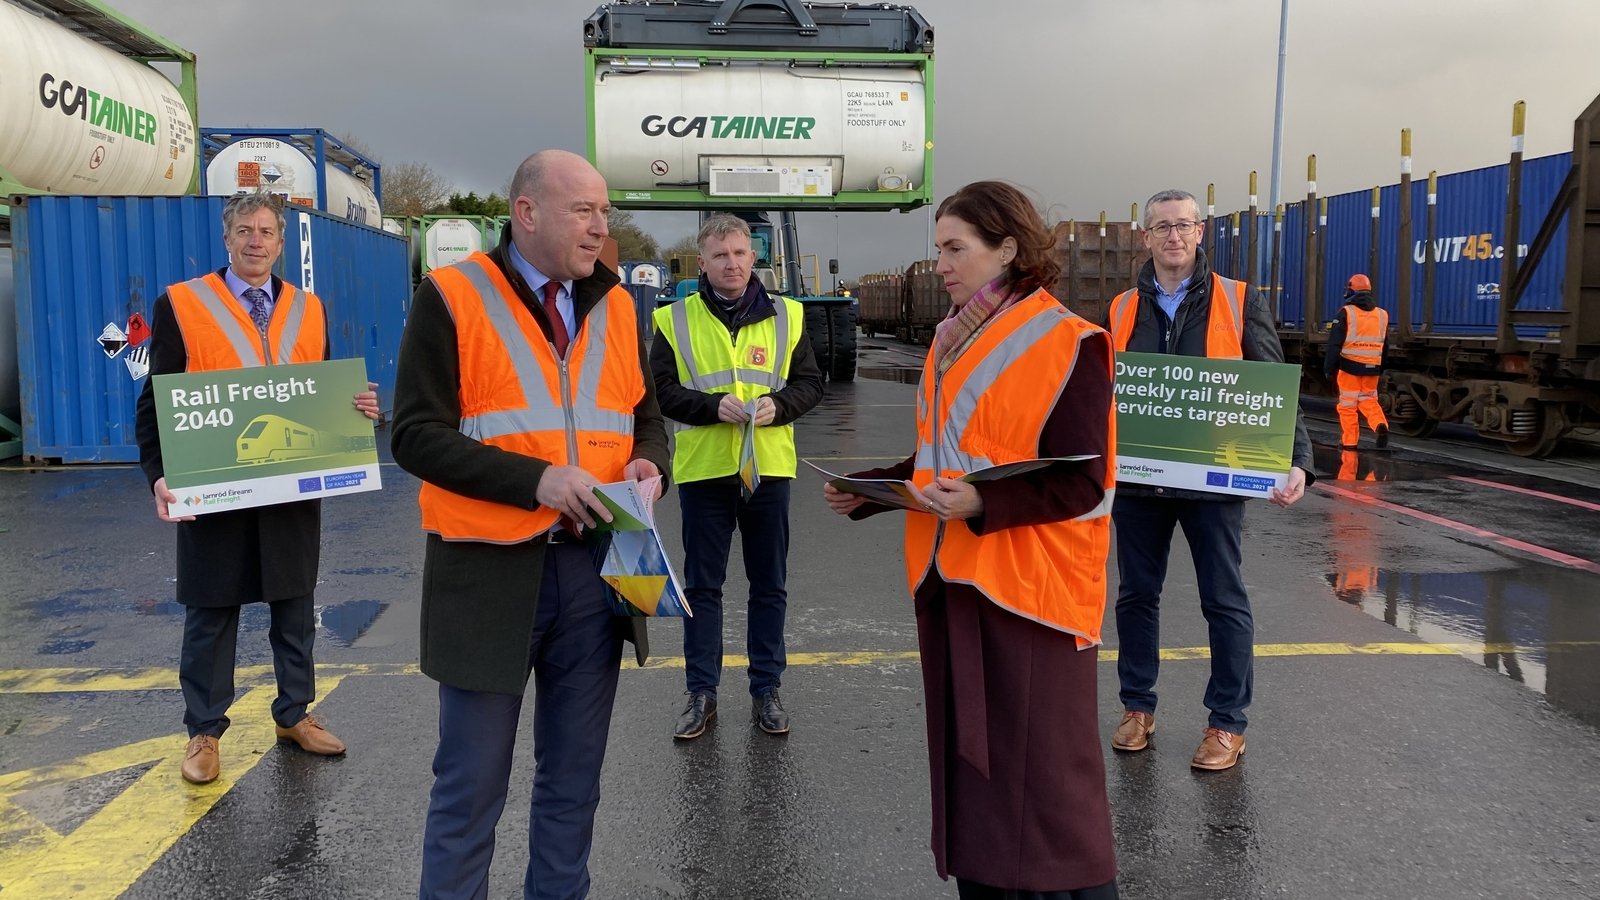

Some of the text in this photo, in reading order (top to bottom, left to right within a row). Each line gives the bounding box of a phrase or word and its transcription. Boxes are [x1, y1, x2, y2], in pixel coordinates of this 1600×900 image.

[39, 72, 157, 146] GCATAINER
[641, 114, 816, 140] GCATAINER
[847, 119, 906, 127] FOODSTUFF ONLY
[240, 141, 255, 149] BTEU
[1115, 361, 1239, 385] Over 100 new
[171, 377, 317, 407] Rail Freight
[1113, 382, 1283, 411] weekly rail freight
[173, 408, 234, 432] 2040
[1188, 406, 1271, 427] targeted
[325, 472, 364, 482] EUROPEAN YEAR
[1131, 470, 1152, 478] Freight
[1233, 476, 1260, 484] EUROPEAN
[217, 495, 241, 503] Freight
